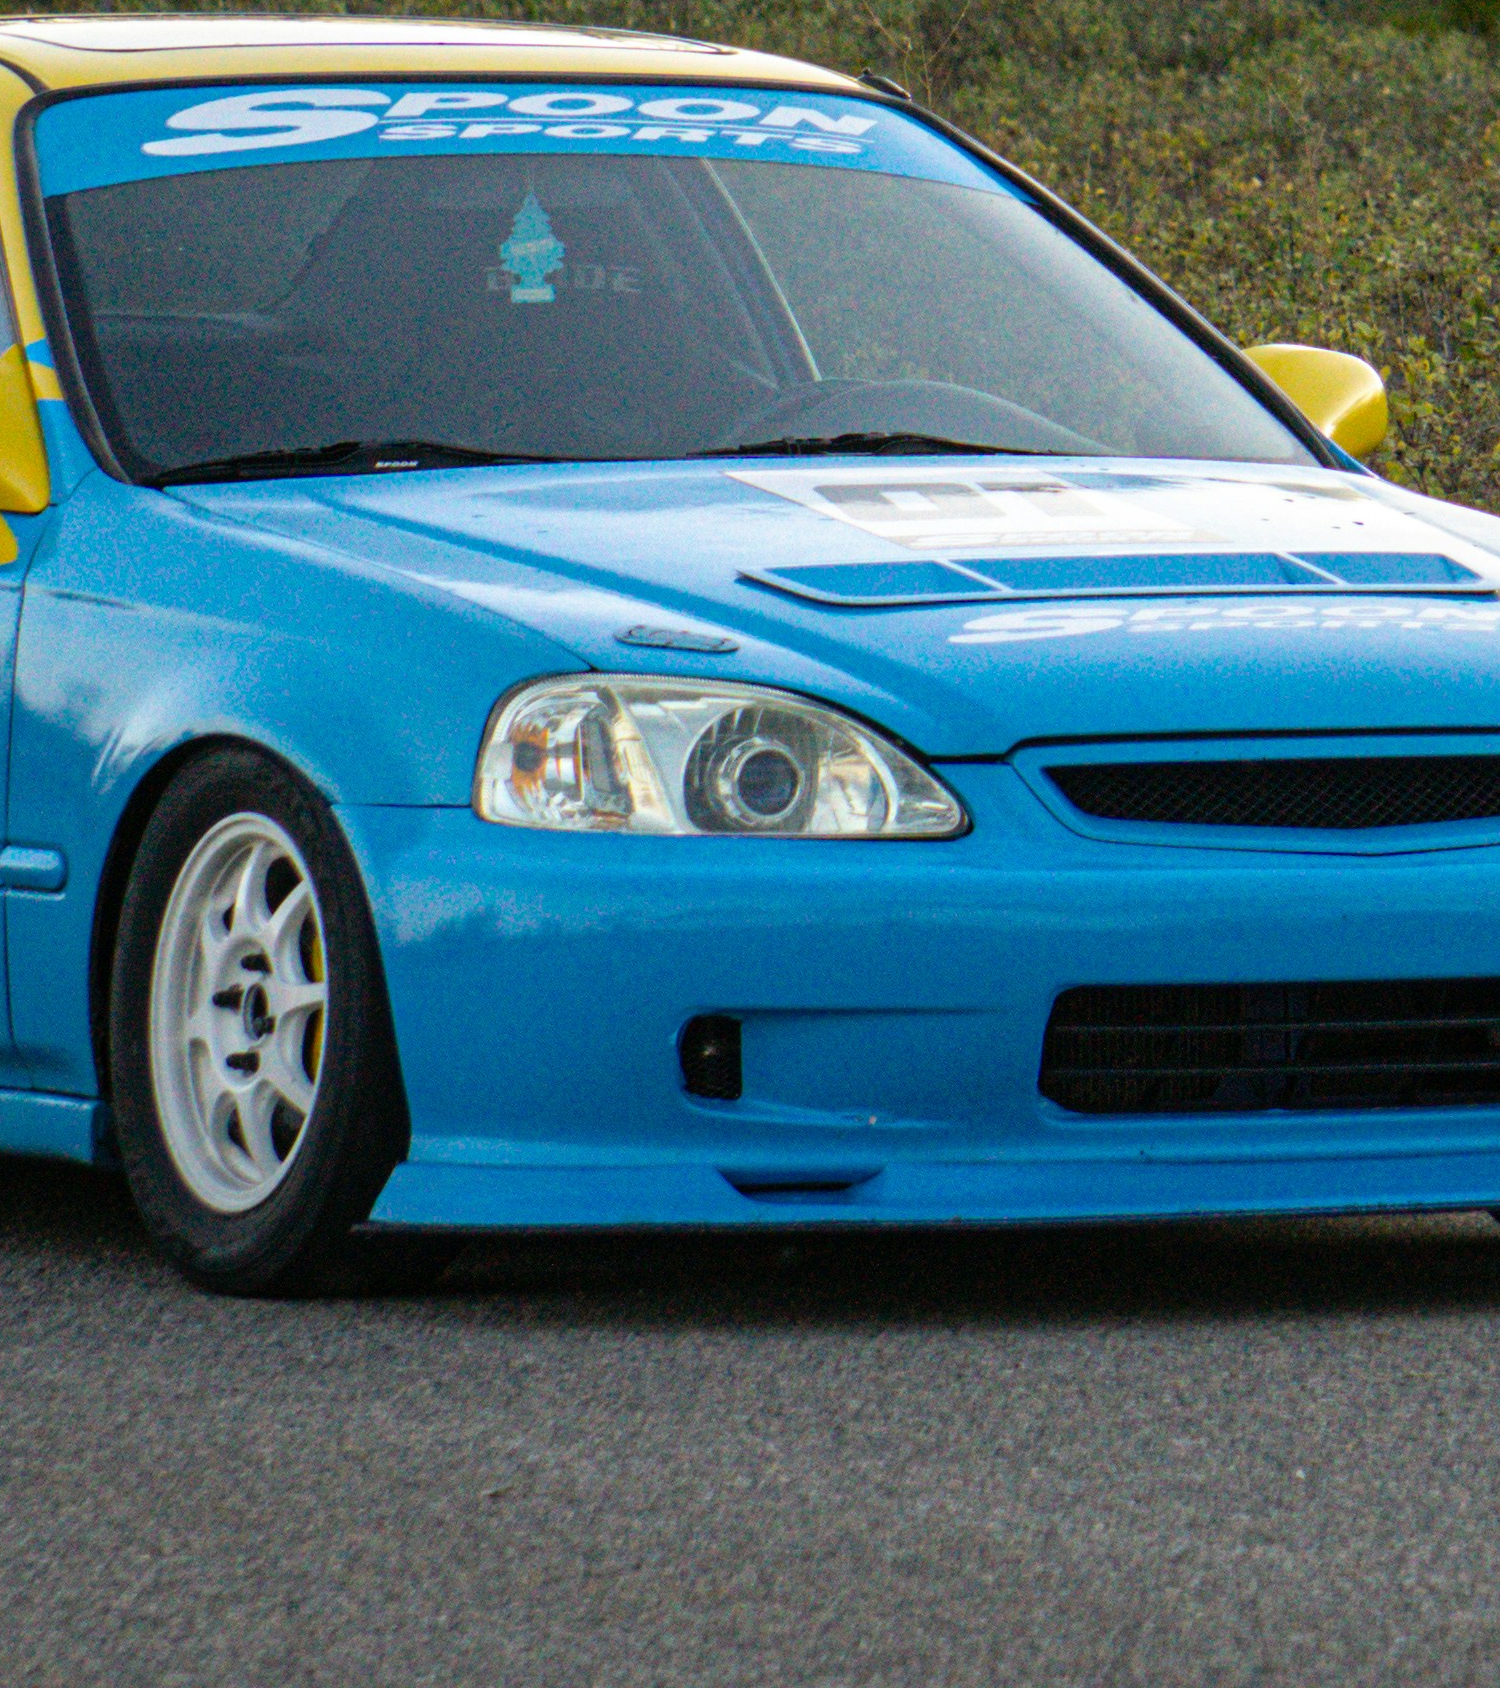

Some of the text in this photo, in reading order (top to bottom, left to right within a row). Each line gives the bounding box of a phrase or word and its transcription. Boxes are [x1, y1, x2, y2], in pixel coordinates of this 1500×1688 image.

[140, 88, 878, 157] SPOON
[378, 123, 862, 154] SPORTS
[373, 460, 420, 469] SPOON
